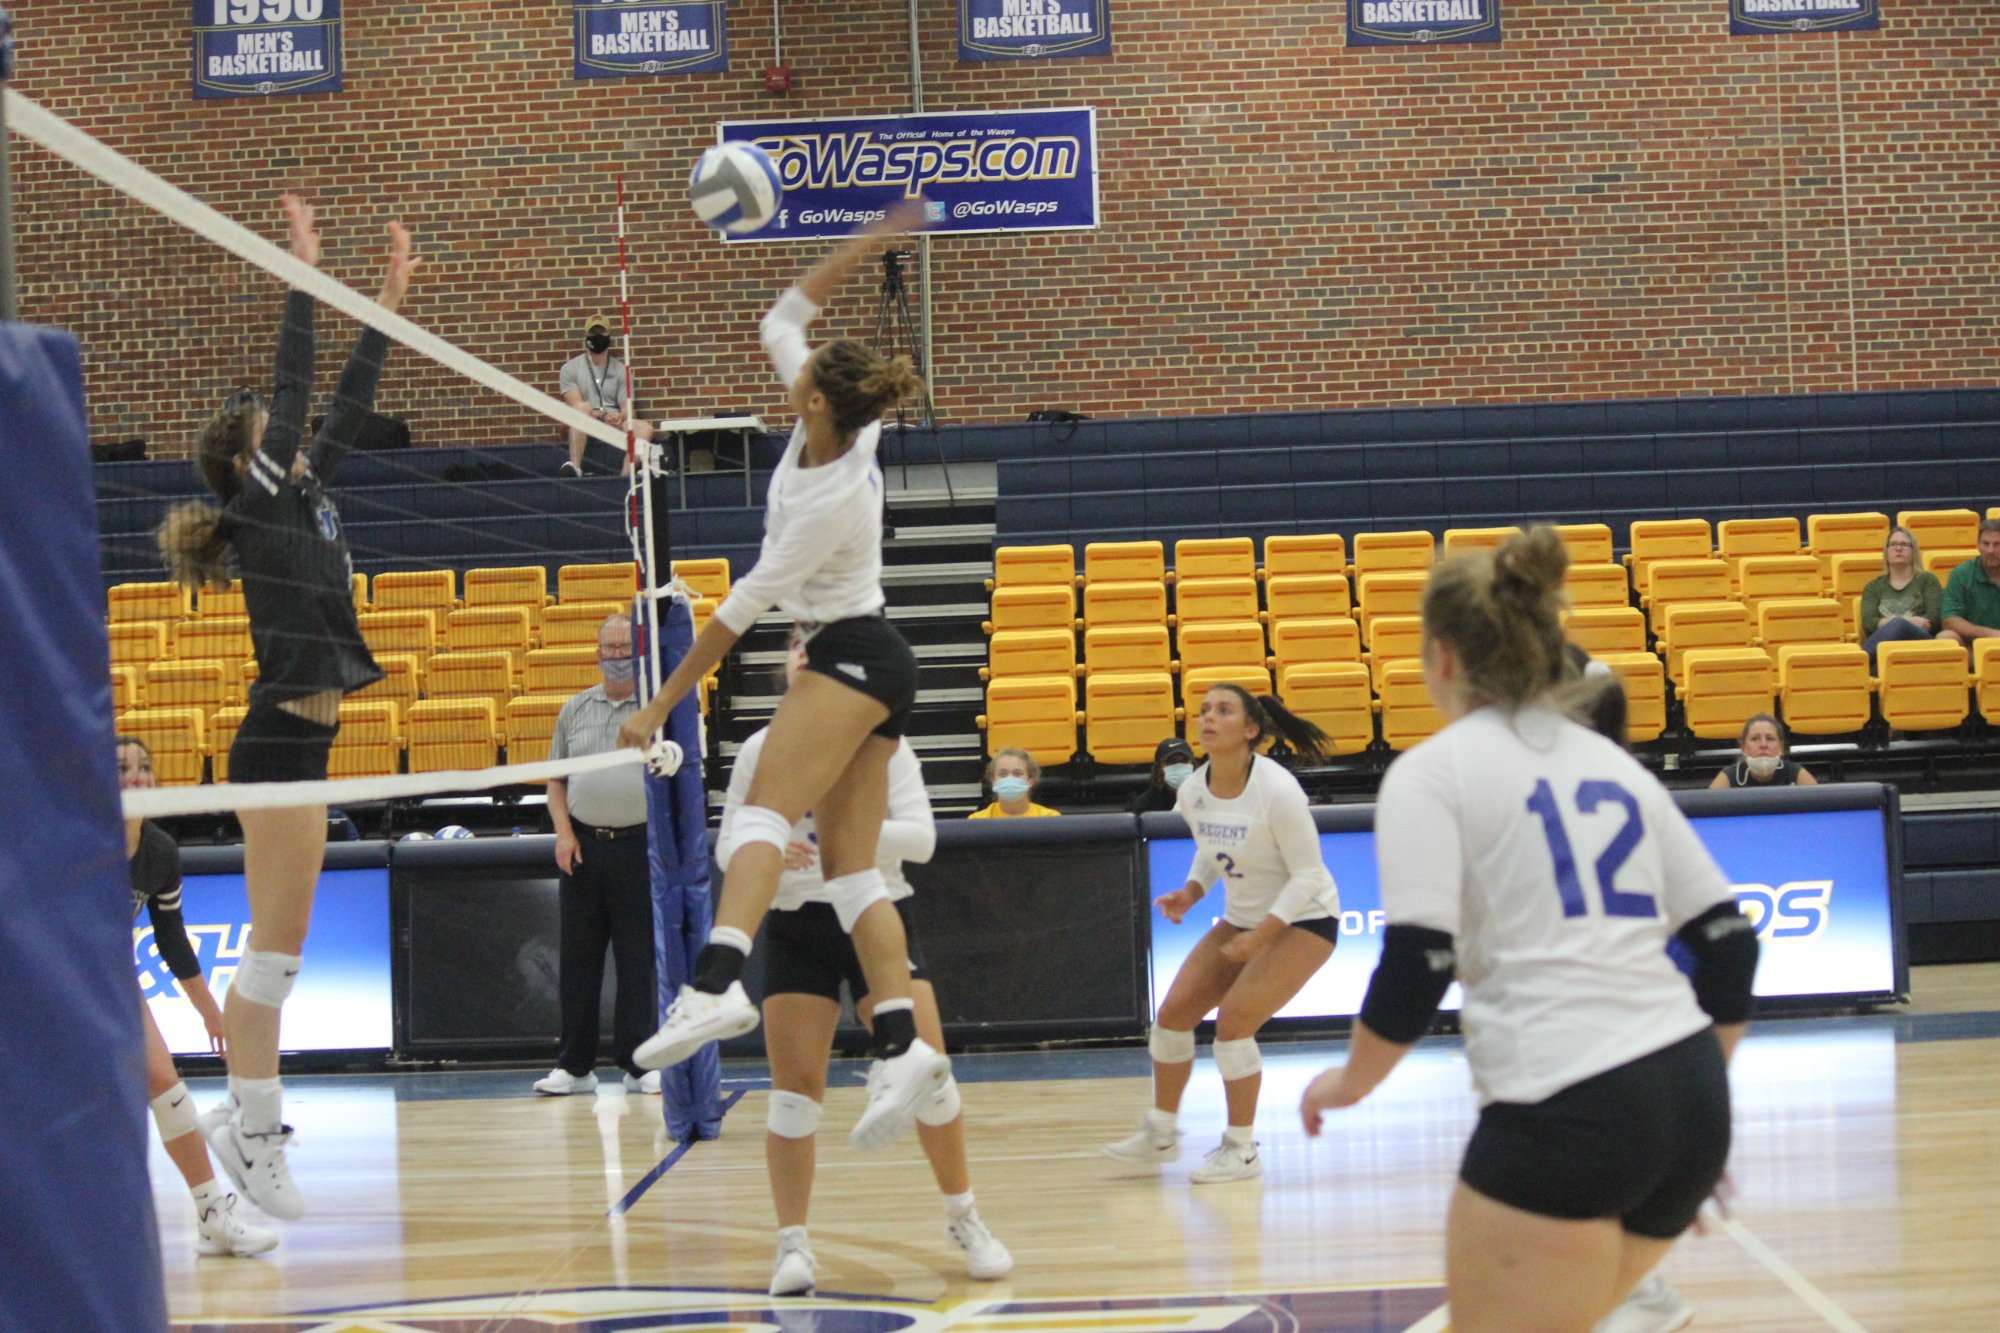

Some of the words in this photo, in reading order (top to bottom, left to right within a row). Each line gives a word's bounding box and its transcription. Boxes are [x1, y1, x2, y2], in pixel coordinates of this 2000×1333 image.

[620, 10, 679, 33] MEN'S
[1363, 0, 1482, 23] BASKETBALL
[973, 12, 1092, 38] BASKETBALL
[237, 31, 294, 54] MEN'S
[592, 29, 710, 55] BASKETBALL
[208, 50, 324, 76] BASKETBALL
[896, 131, 926, 139] Official
[798, 208, 886, 224] GoWasps
[953, 200, 1058, 218] @GoWasps
[1198, 822, 1248, 839] REGENT
[1526, 776, 1659, 918] 12
[1216, 852, 1245, 878] 2
